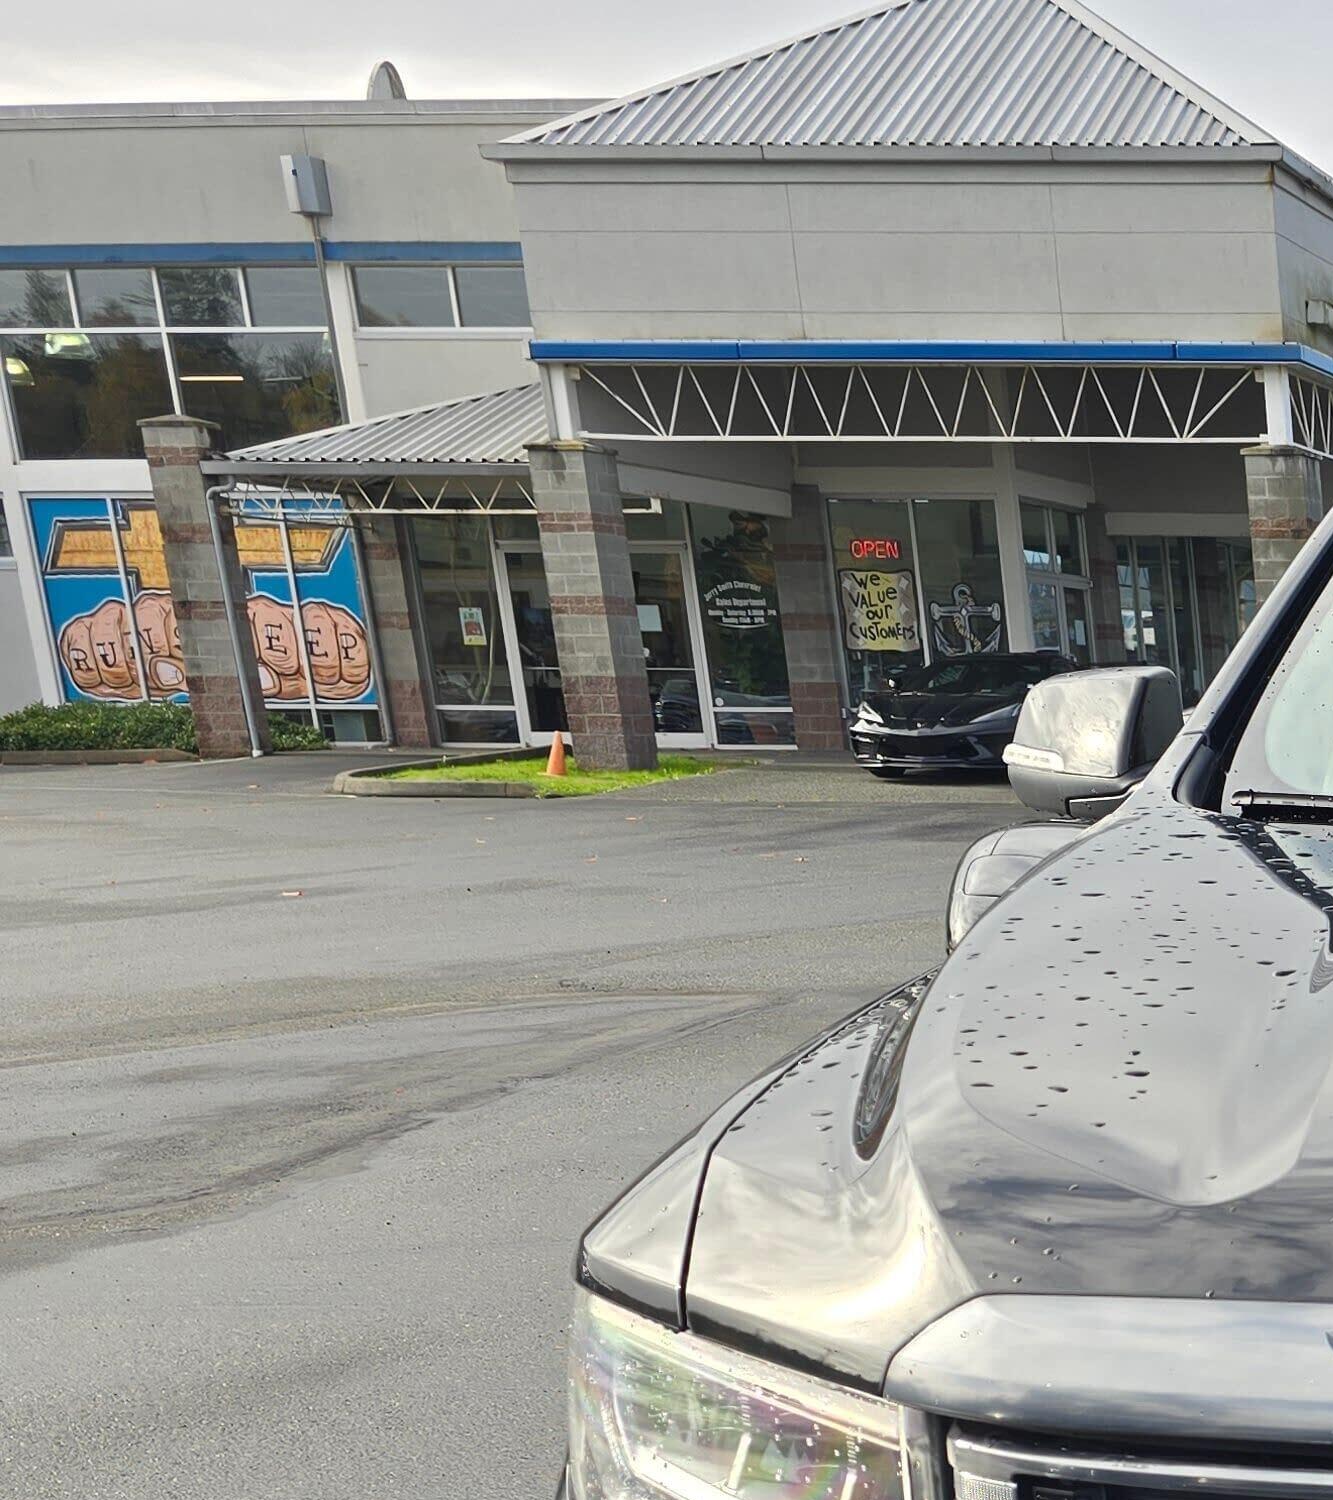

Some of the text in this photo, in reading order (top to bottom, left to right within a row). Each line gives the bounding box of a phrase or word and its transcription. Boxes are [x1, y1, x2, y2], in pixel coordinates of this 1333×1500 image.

[851, 540, 899, 559] OPEN
[851, 572, 881, 590] We
[263, 622, 358, 659] EEP
